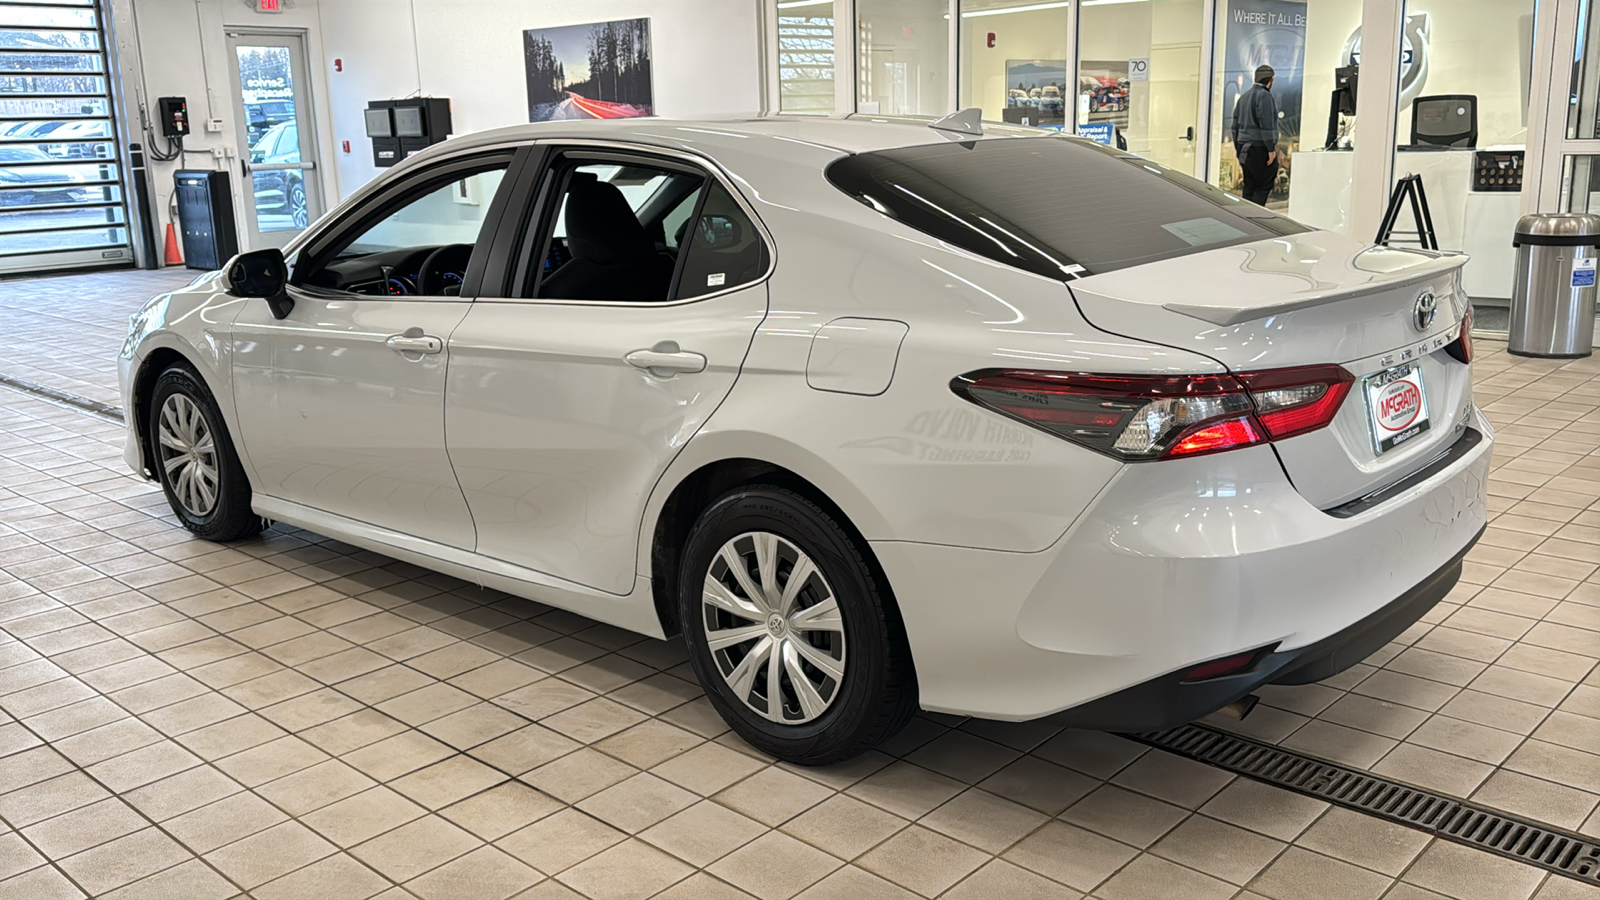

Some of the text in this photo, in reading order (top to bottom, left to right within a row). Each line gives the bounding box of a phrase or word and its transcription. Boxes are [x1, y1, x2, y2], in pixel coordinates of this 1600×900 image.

[1234, 9, 1266, 24] WHERE
[1268, 12, 1276, 24] IT
[1277, 13, 1293, 26] ALL
[1131, 61, 1146, 72] 70
